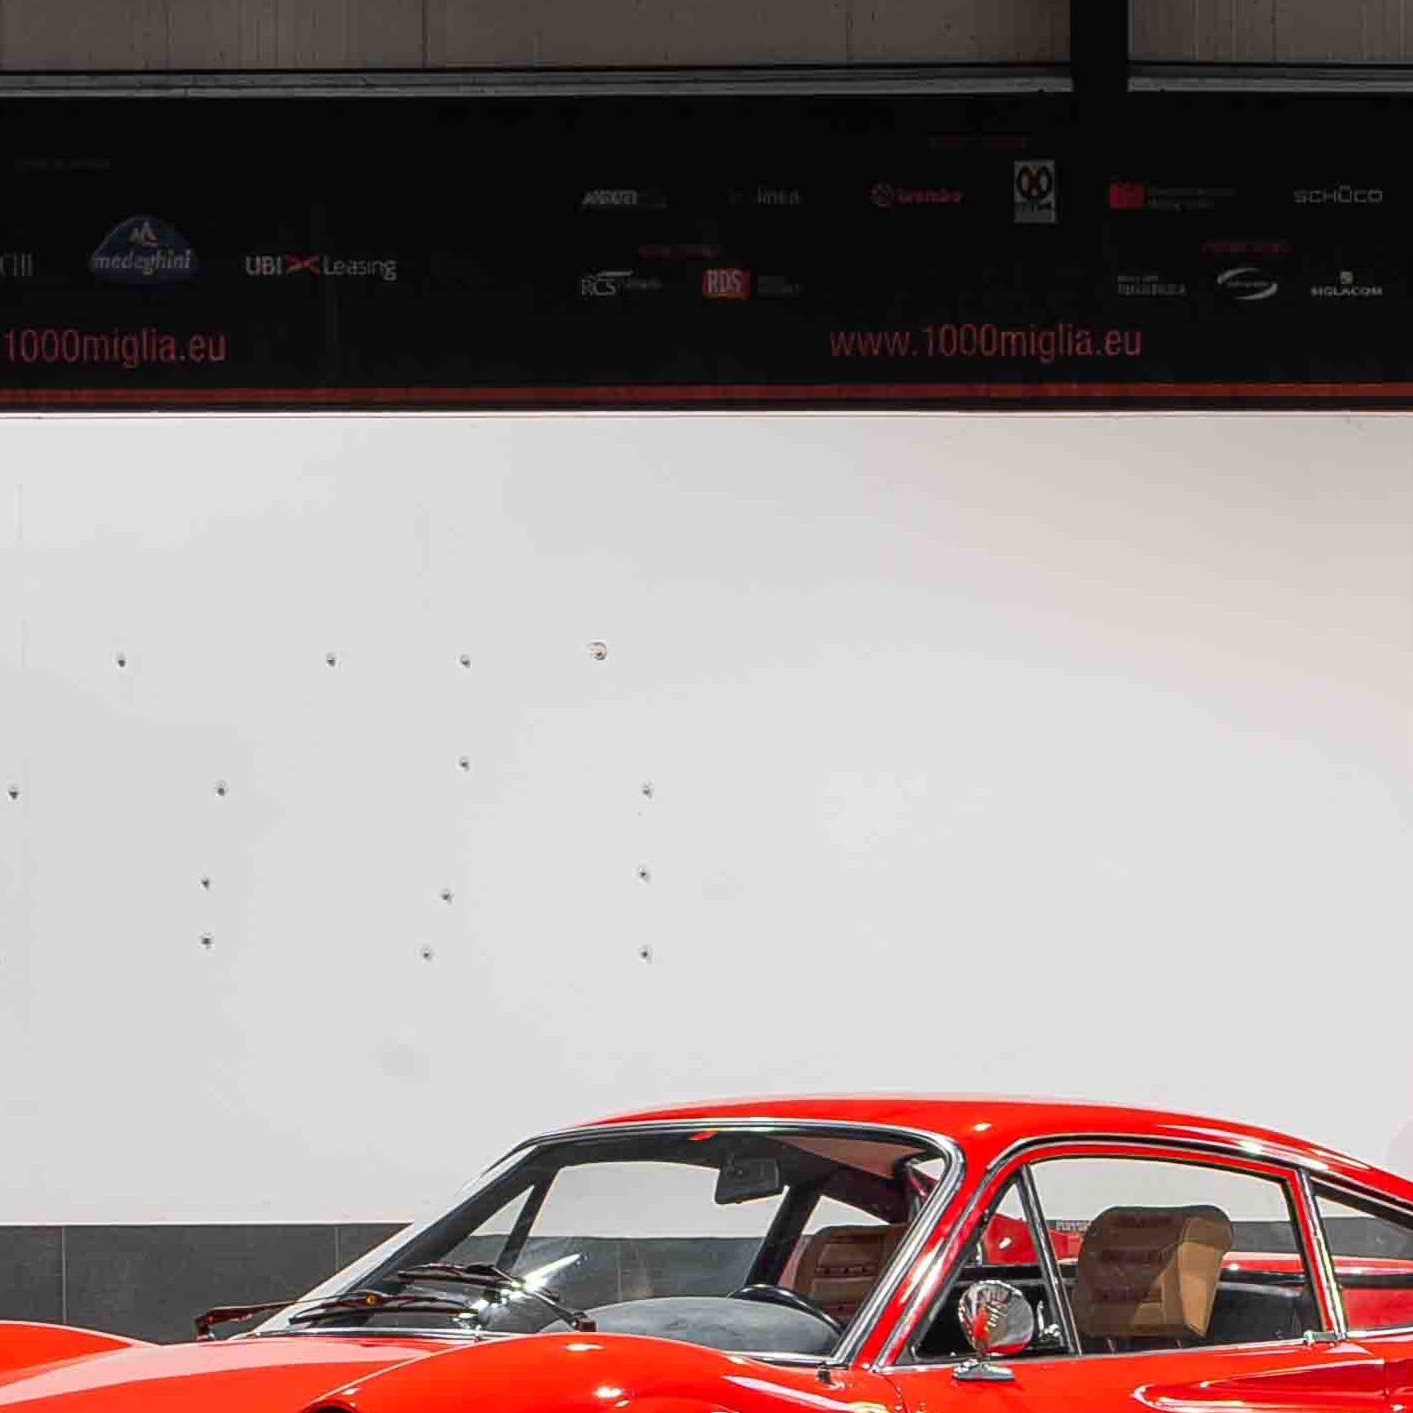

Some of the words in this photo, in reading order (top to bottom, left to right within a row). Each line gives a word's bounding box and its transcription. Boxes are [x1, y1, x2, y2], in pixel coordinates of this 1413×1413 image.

[245, 254, 283, 276] UBI
[323, 254, 399, 282] Leasing
[705, 267, 743, 293] RDS
[829, 323, 1143, 365] www.1000miglia.eu
